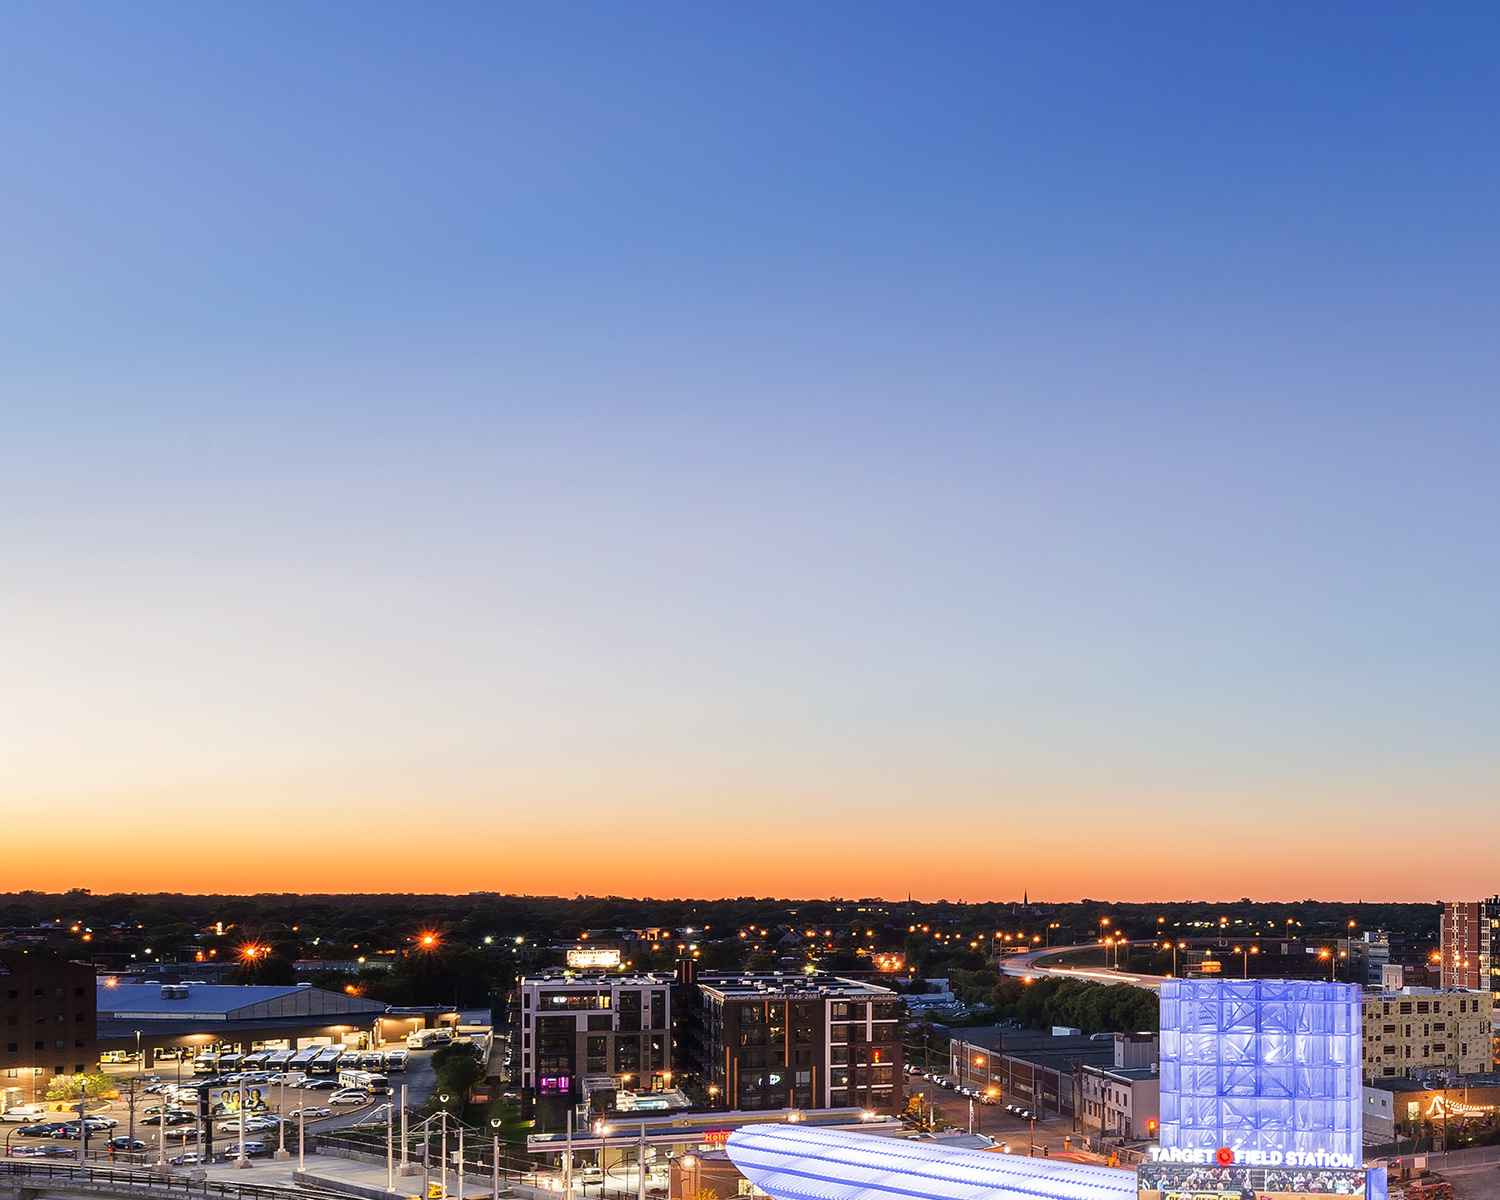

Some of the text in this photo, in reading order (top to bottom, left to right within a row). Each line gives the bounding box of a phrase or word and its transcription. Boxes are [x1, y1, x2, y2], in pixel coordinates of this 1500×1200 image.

[1149, 1147, 1354, 1167] TARGET FIELD STATION
